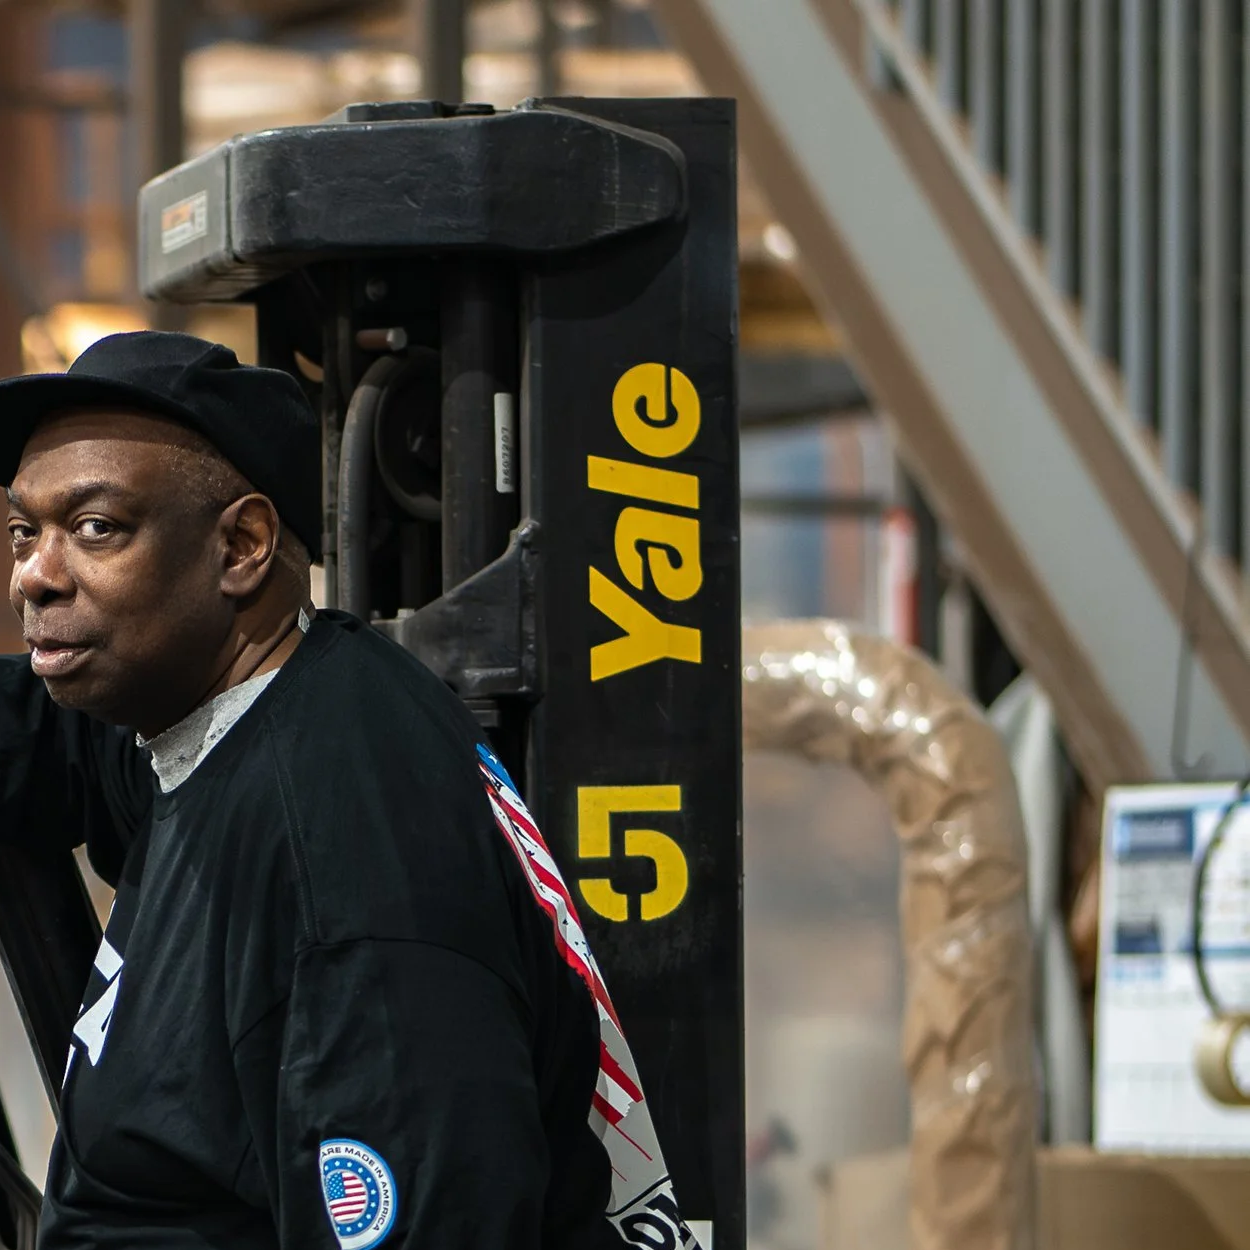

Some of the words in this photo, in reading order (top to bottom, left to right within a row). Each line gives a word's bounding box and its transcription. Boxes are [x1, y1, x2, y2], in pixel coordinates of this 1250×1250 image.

[587, 362, 703, 682] Yale
[577, 785, 689, 923] 5
[344, 1147, 375, 1167] MADE
[374, 1166, 384, 1179] IN
[372, 1181, 390, 1231] AMERICA
